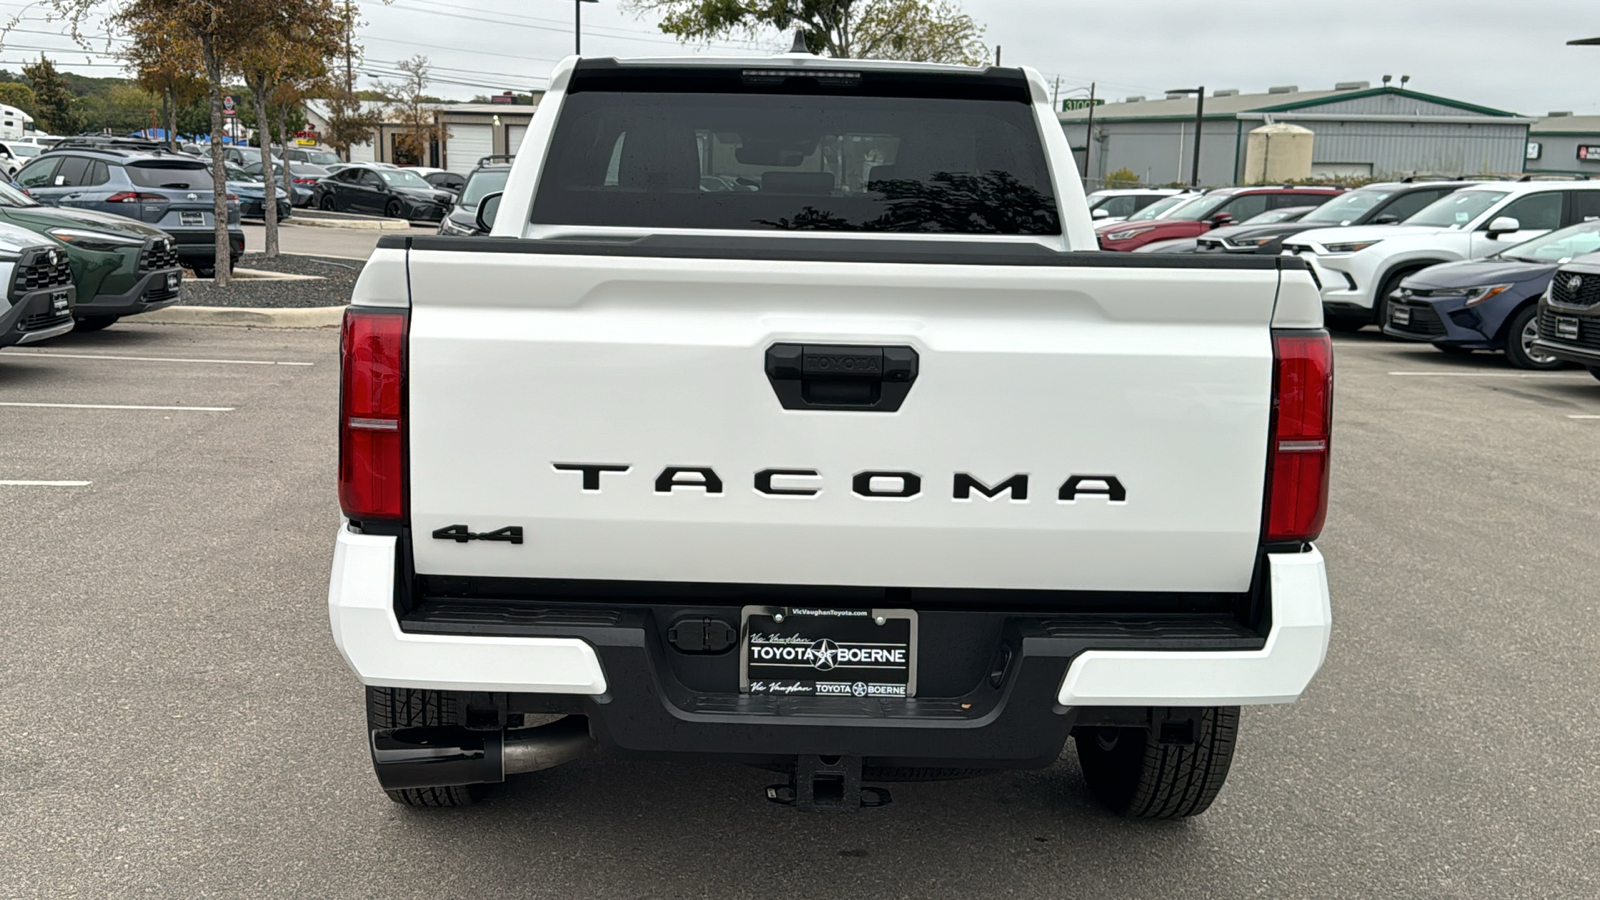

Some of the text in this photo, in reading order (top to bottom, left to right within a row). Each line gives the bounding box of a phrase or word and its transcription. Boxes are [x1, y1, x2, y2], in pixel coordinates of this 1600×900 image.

[806, 354, 879, 371] TOYOTA
[551, 462, 1128, 503] TACOMA
[792, 608, 868, 617] VicVaughanToyota.com
[750, 632, 811, 645] Vic Vaughan
[751, 647, 813, 660] TOYOTA
[837, 648, 906, 663] BOERNE
[750, 681, 766, 692] Vic
[769, 681, 812, 694] Vaughan
[816, 684, 851, 693] TOYOTA
[868, 685, 906, 694] BOERNE
